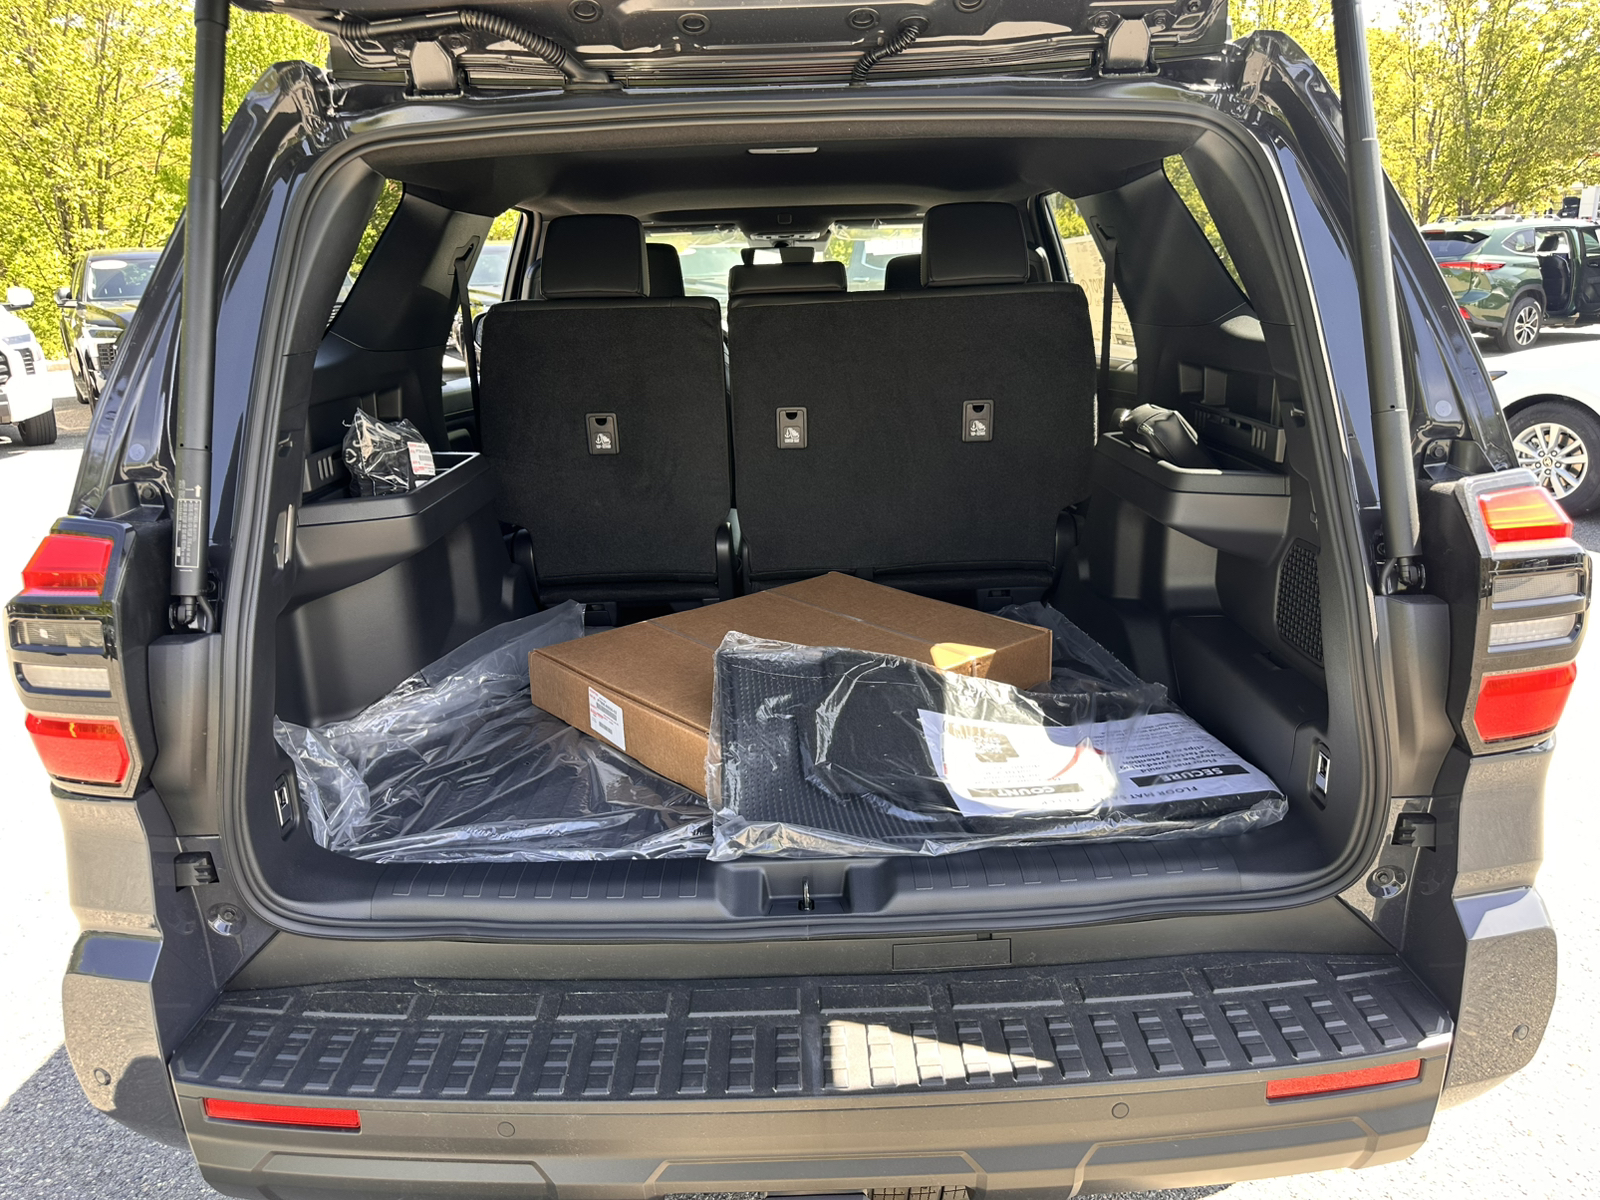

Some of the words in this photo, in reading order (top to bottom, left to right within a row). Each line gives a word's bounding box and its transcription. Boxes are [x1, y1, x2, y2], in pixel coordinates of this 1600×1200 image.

[1193, 758, 1218, 766] Floor
[1162, 767, 1224, 783] SECURE
[997, 786, 1056, 797] COUNT
[1129, 791, 1156, 800] MAT
[1159, 785, 1199, 797] FLOOR
